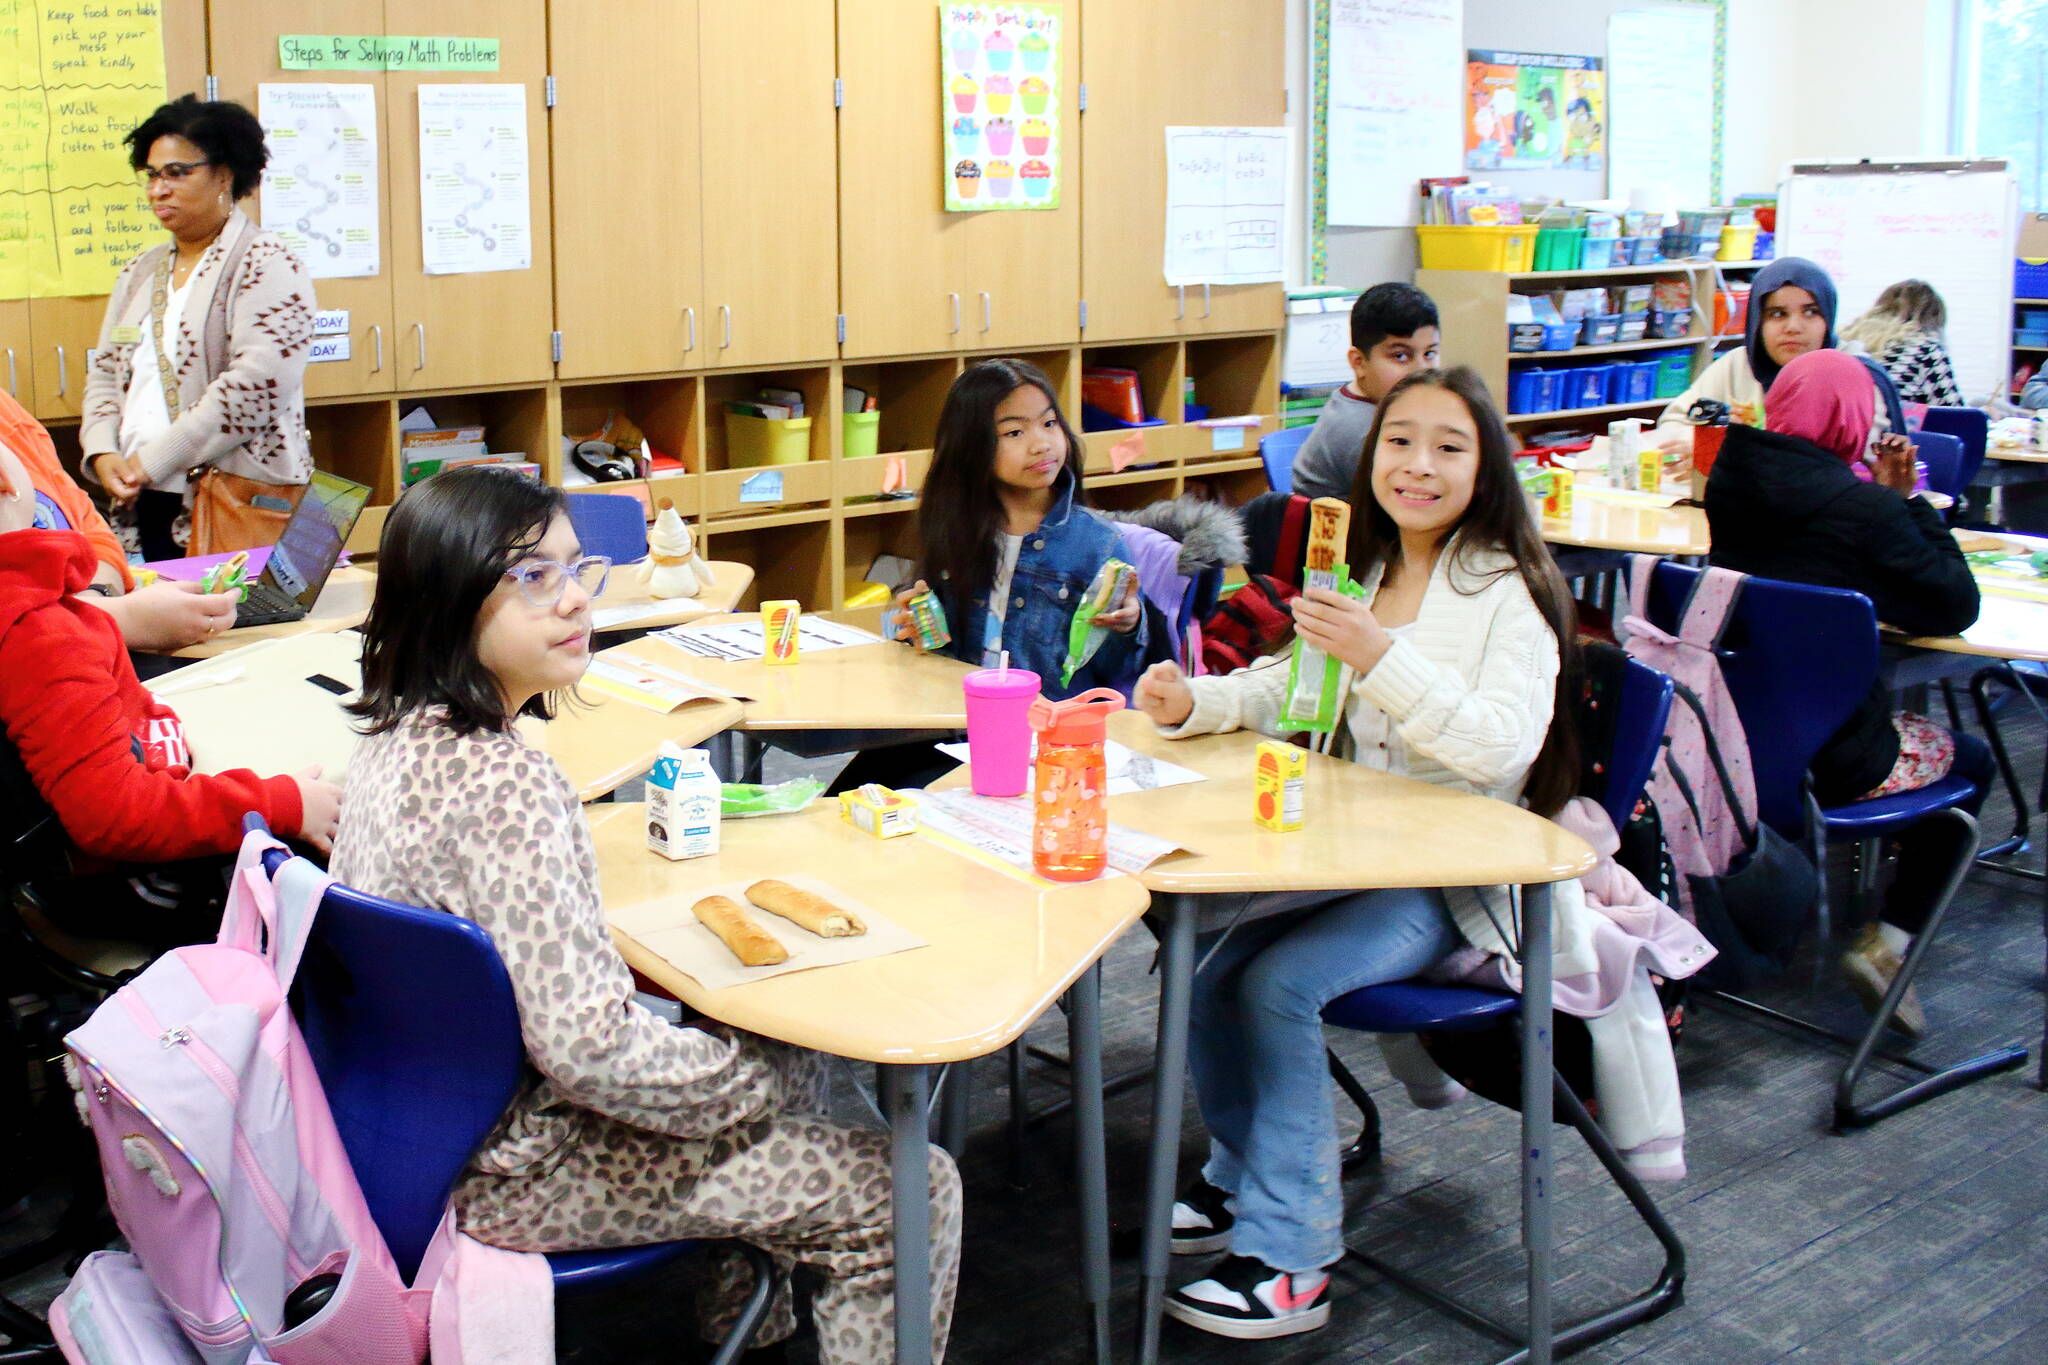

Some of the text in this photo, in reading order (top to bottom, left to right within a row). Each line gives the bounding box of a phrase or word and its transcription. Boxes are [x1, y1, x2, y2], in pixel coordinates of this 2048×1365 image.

[47, 2, 157, 24] Keep food on table
[52, 28, 146, 45] pick up your
[283, 37, 497, 68] Steps for Solving Math Problems
[52, 53, 136, 73] speak kindly
[60, 101, 98, 116] Walk
[102, 139, 116, 151] to
[69, 198, 91, 215] eat
[103, 203, 129, 217] your
[71, 222, 93, 235] and
[105, 220, 143, 233] follow
[74, 240, 143, 255] and teacher
[315, 316, 343, 328] RDAY
[310, 344, 337, 357] DAY
